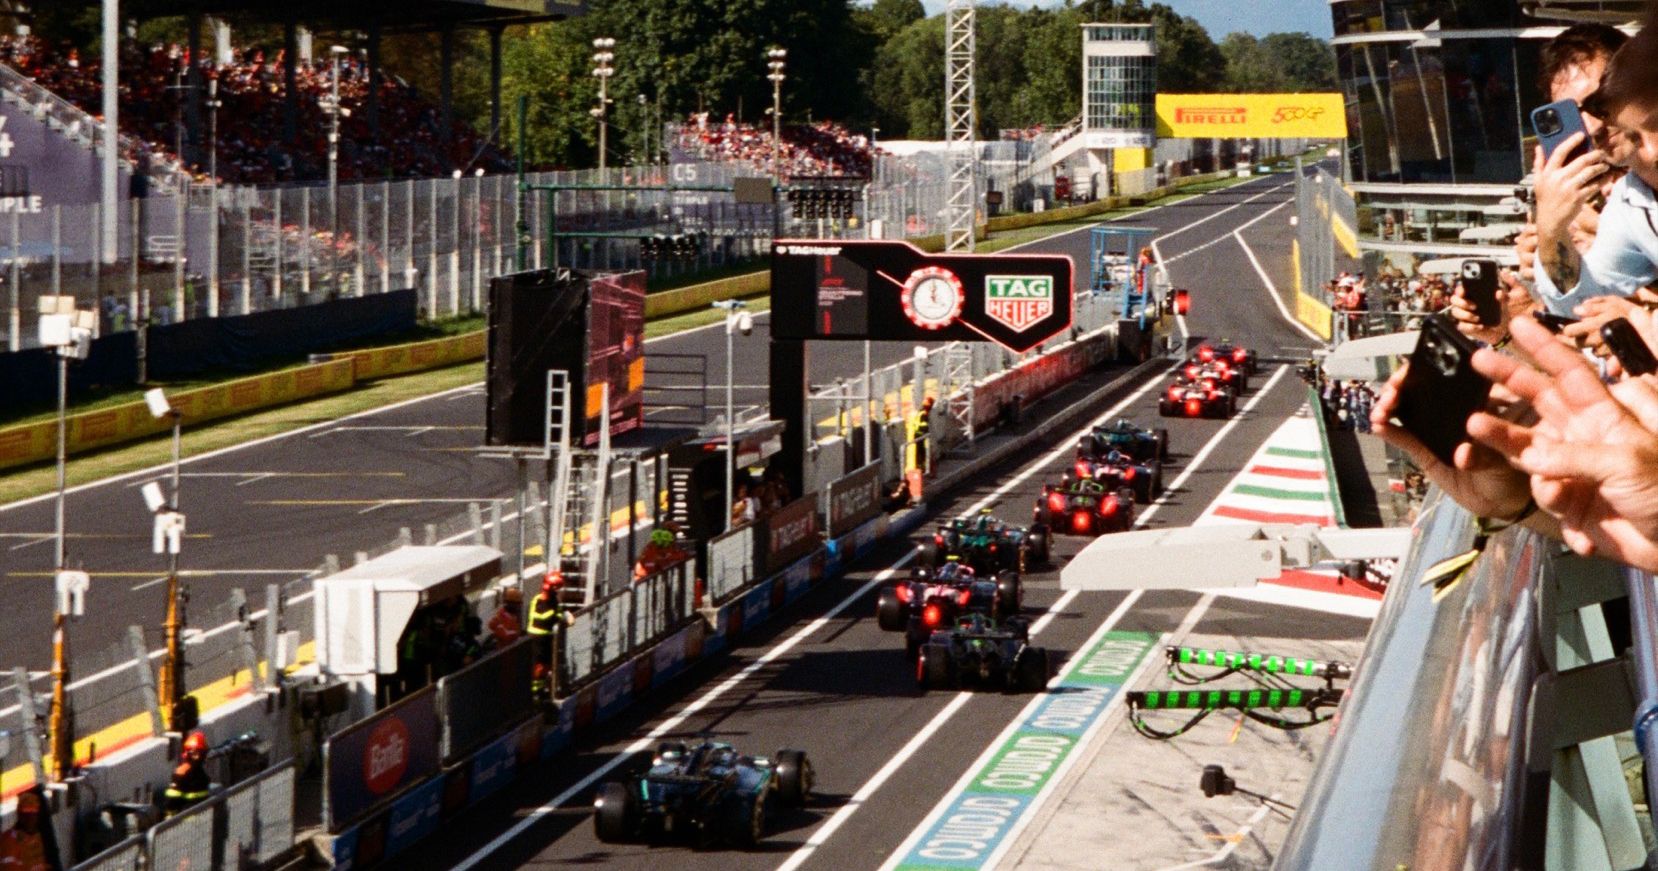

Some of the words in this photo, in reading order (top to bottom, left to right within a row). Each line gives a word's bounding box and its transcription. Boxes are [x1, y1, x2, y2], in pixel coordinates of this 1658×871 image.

[1175, 107, 1247, 124] PIRELLI
[673, 163, 697, 181] C5
[991, 279, 1047, 297] TAG
[990, 300, 1049, 329] HEUER
[982, 736, 1071, 789] aramco
[919, 797, 1020, 860] aramco
